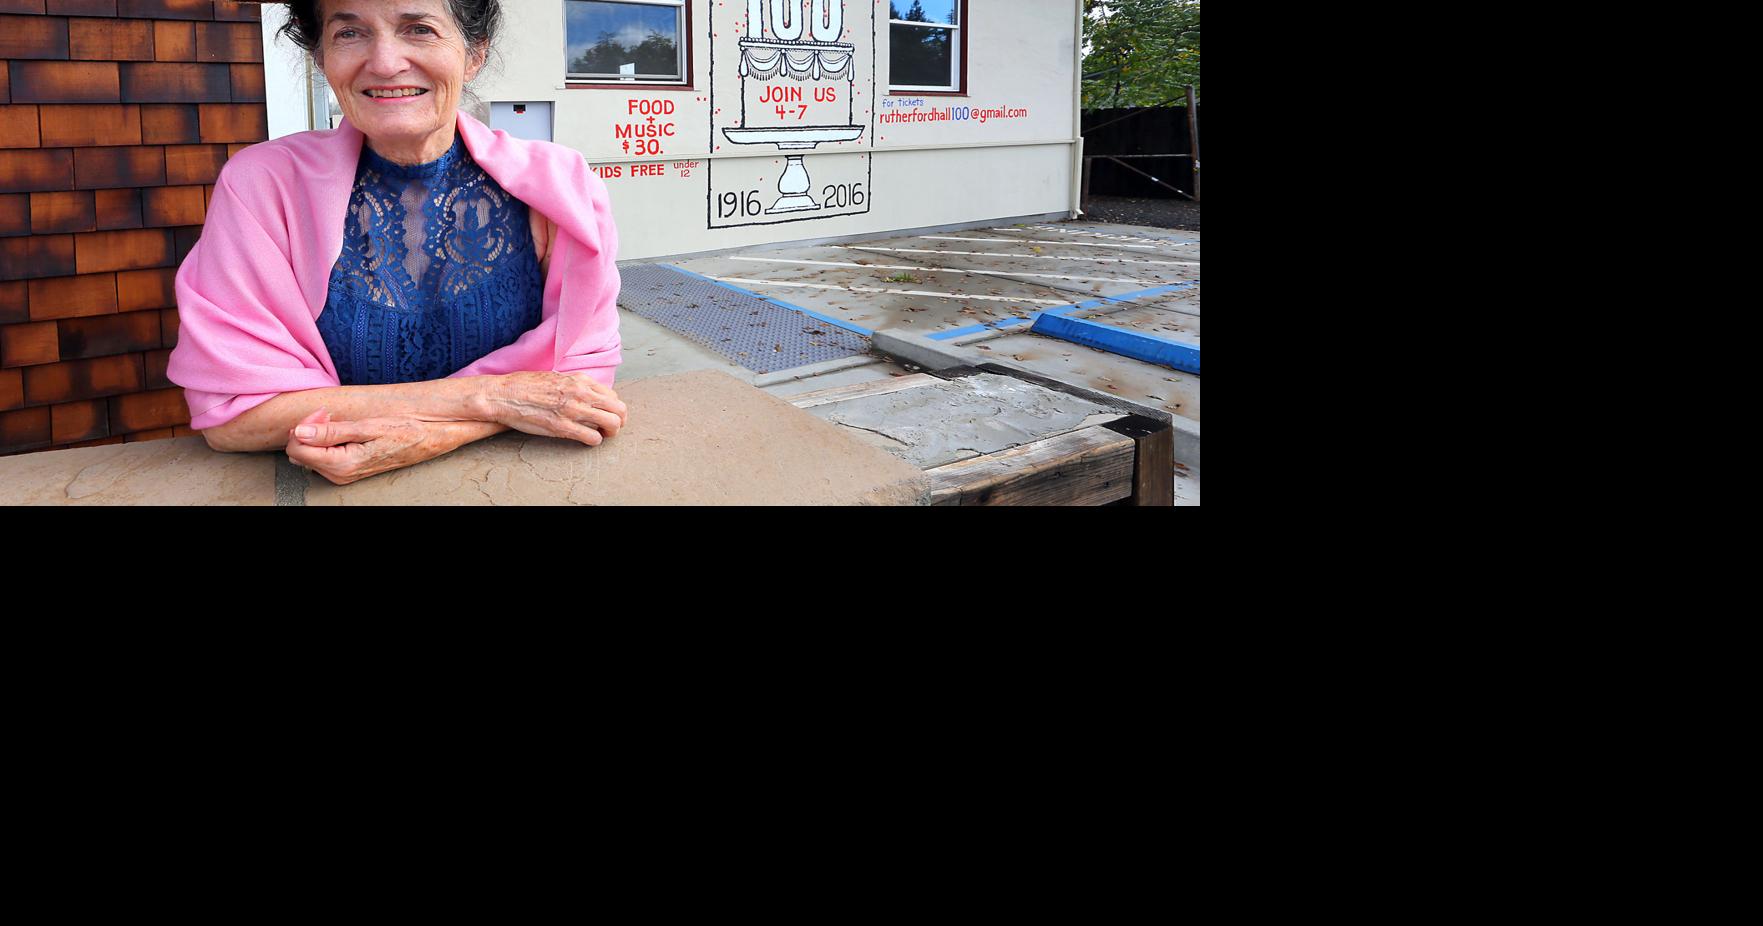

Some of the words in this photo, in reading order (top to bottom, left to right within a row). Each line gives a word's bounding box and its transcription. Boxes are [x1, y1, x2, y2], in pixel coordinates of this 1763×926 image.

[759, 85, 802, 103] JOIN
[814, 86, 836, 102] US
[628, 99, 675, 115] FOOD
[882, 100, 894, 108] for
[898, 98, 925, 107] tickets
[775, 104, 808, 120] 4-7
[879, 105, 1028, 123] rutherfordhall100@gmail.com
[615, 122, 675, 139] MUSIC
[590, 165, 622, 179] IDS
[630, 163, 665, 178] FREE
[673, 158, 700, 170] under
[680, 169, 691, 178] 12
[822, 182, 865, 209] 2016
[718, 190, 761, 218] 1916
